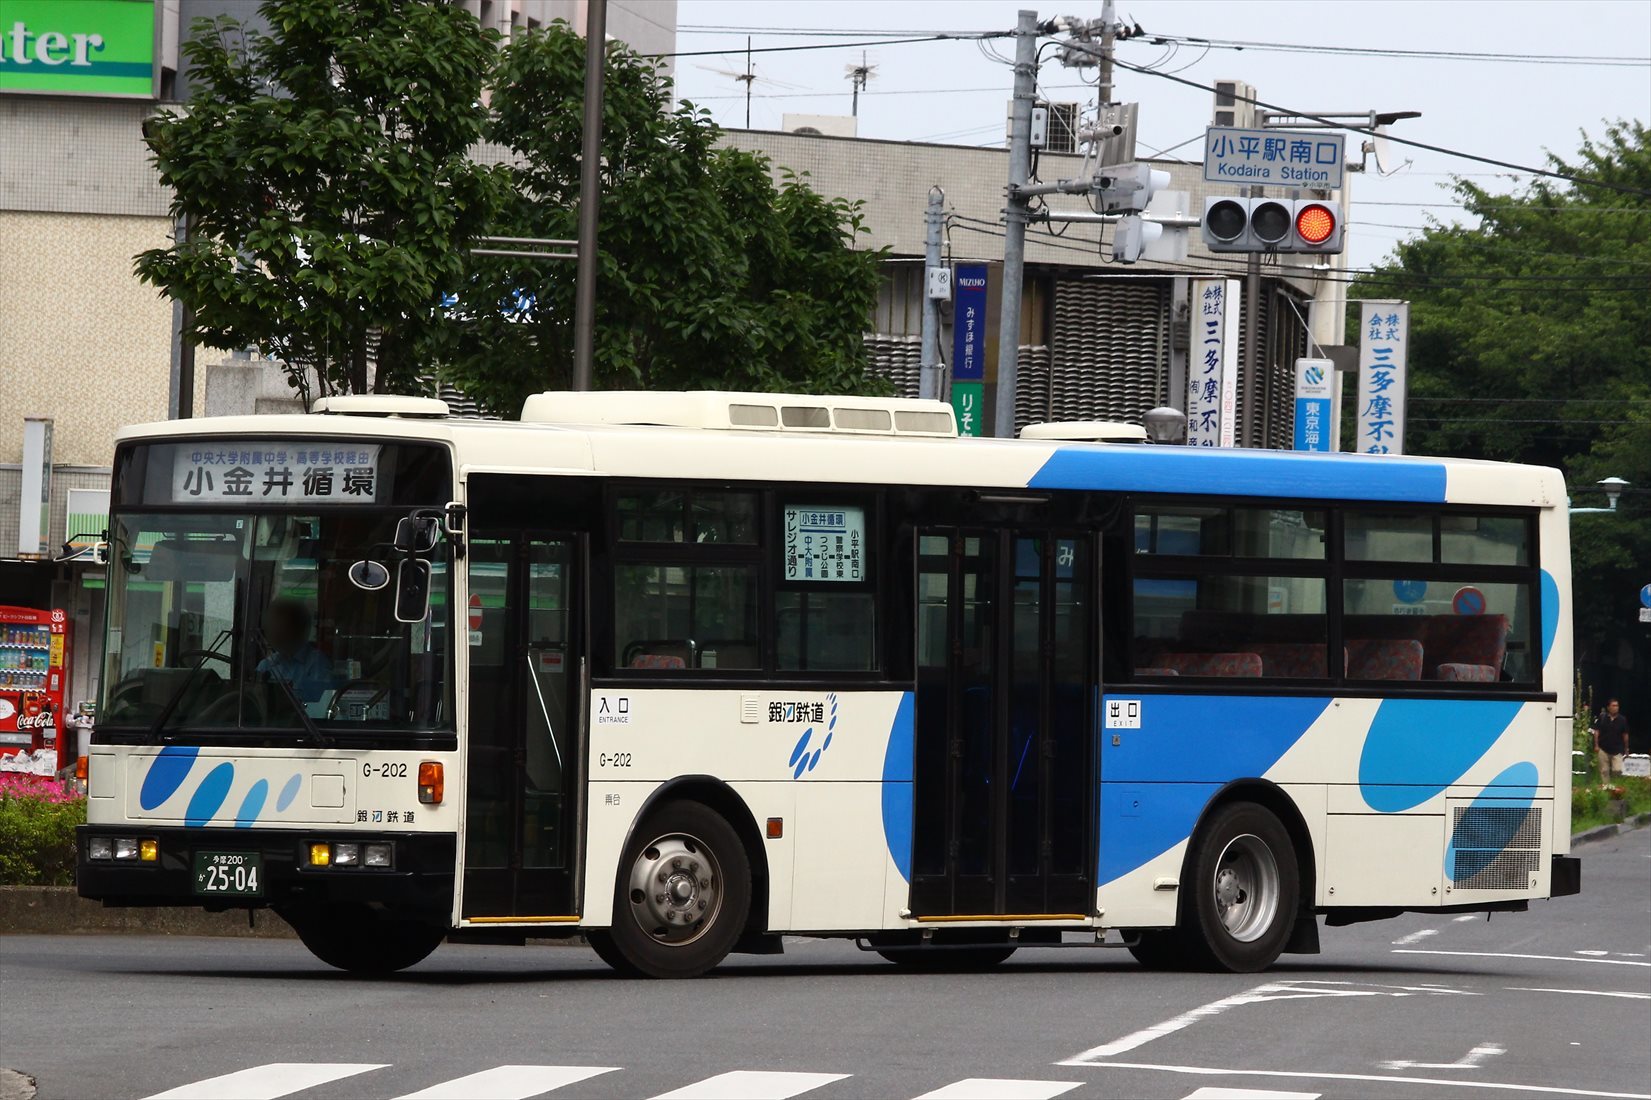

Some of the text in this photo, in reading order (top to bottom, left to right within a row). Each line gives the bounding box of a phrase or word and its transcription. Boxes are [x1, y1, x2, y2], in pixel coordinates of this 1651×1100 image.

[0, 21, 103, 66] ter
[1212, 135, 1337, 165] 小平駅南口
[1218, 162, 1328, 181] Kodaira Station
[959, 278, 986, 287] MIZUHO
[964, 307, 975, 369] みずほ銀行
[183, 466, 374, 496] 小金井循環
[802, 513, 844, 526] 小金井循環
[787, 510, 798, 577] サレジオ通り
[851, 530, 860, 578] 小平駅南口
[599, 697, 629, 714] 入口
[768, 701, 824, 723] 銀河鉄道
[1111, 702, 1137, 718] 出口
[17, 711, 56, 730] Coca-Cola
[599, 716, 629, 724] ENTRANCE
[600, 752, 632, 767] G-202
[363, 762, 407, 778] G-202
[357, 809, 415, 824] 銀河鉄道
[207, 865, 258, 892] 25-04
